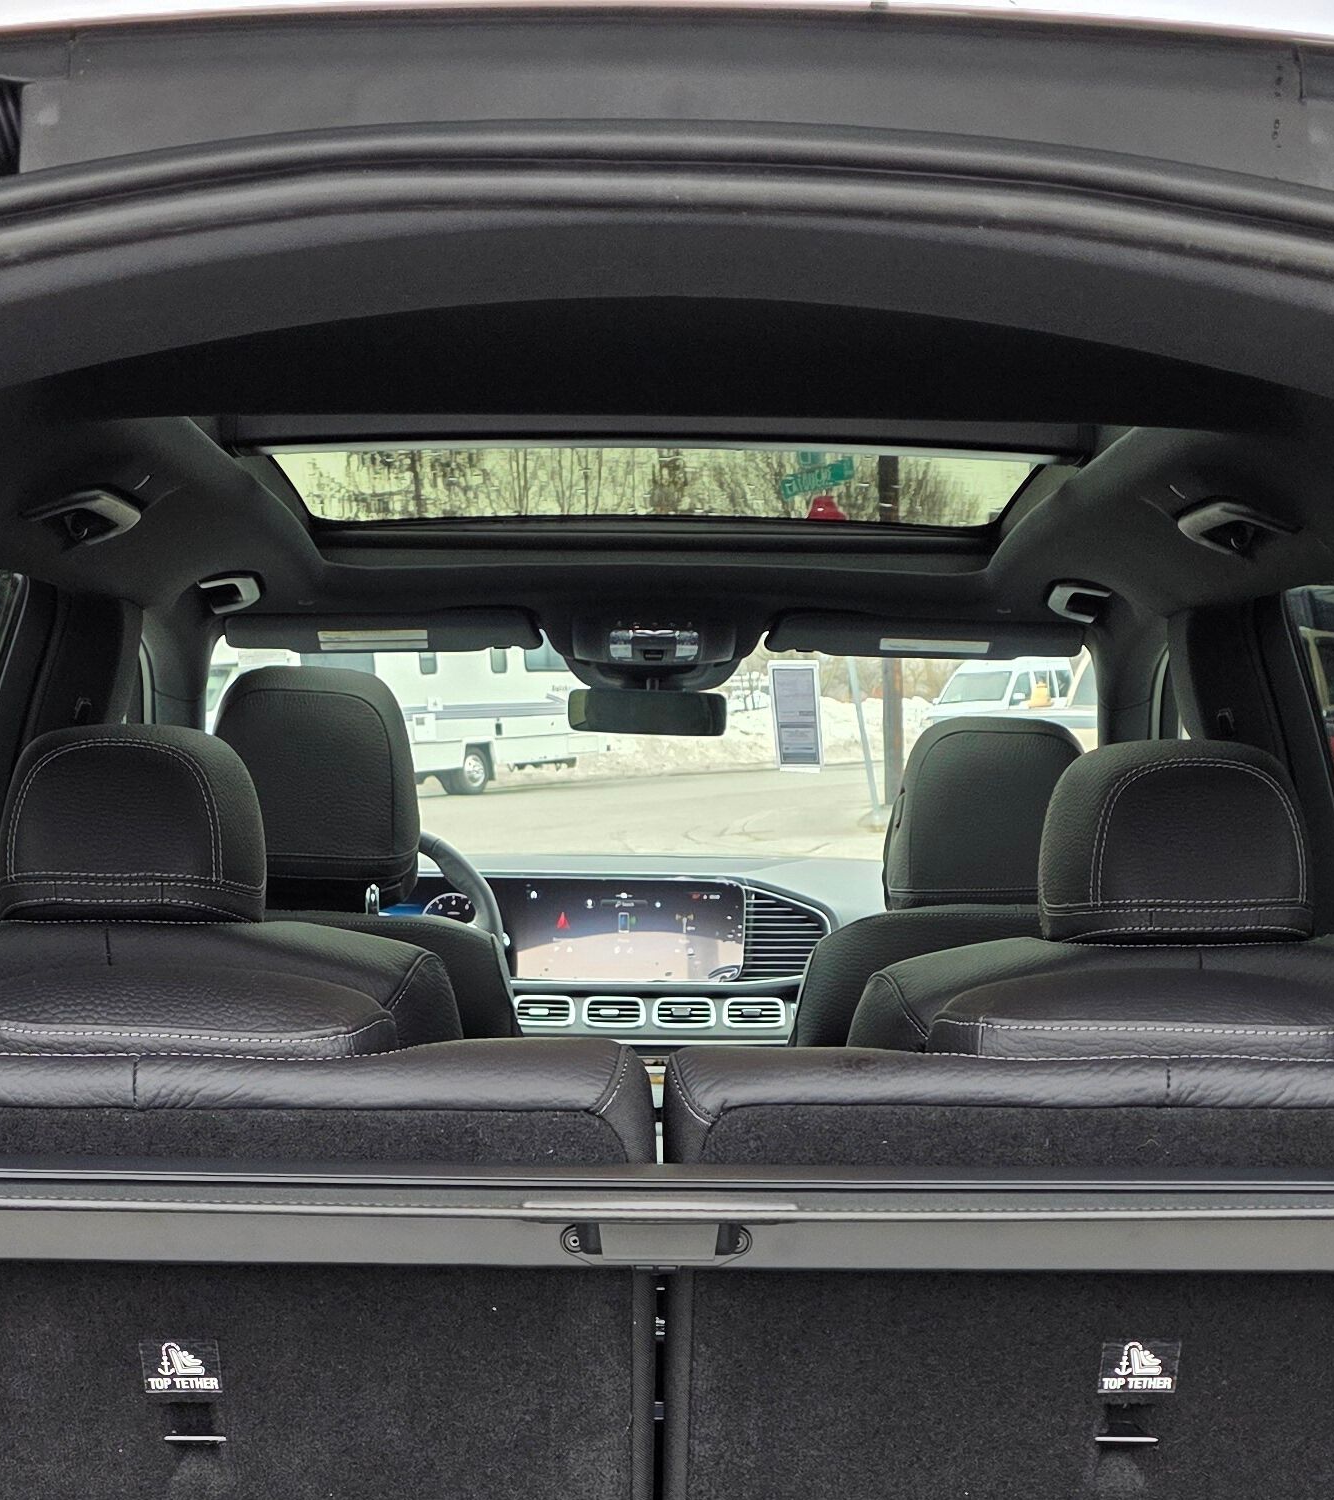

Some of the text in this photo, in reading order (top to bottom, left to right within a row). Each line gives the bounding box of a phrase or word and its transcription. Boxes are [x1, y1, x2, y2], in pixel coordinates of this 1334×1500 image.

[148, 1377, 219, 1390] TOP TETHER
[1102, 1377, 1172, 1390] TOP TETHER
